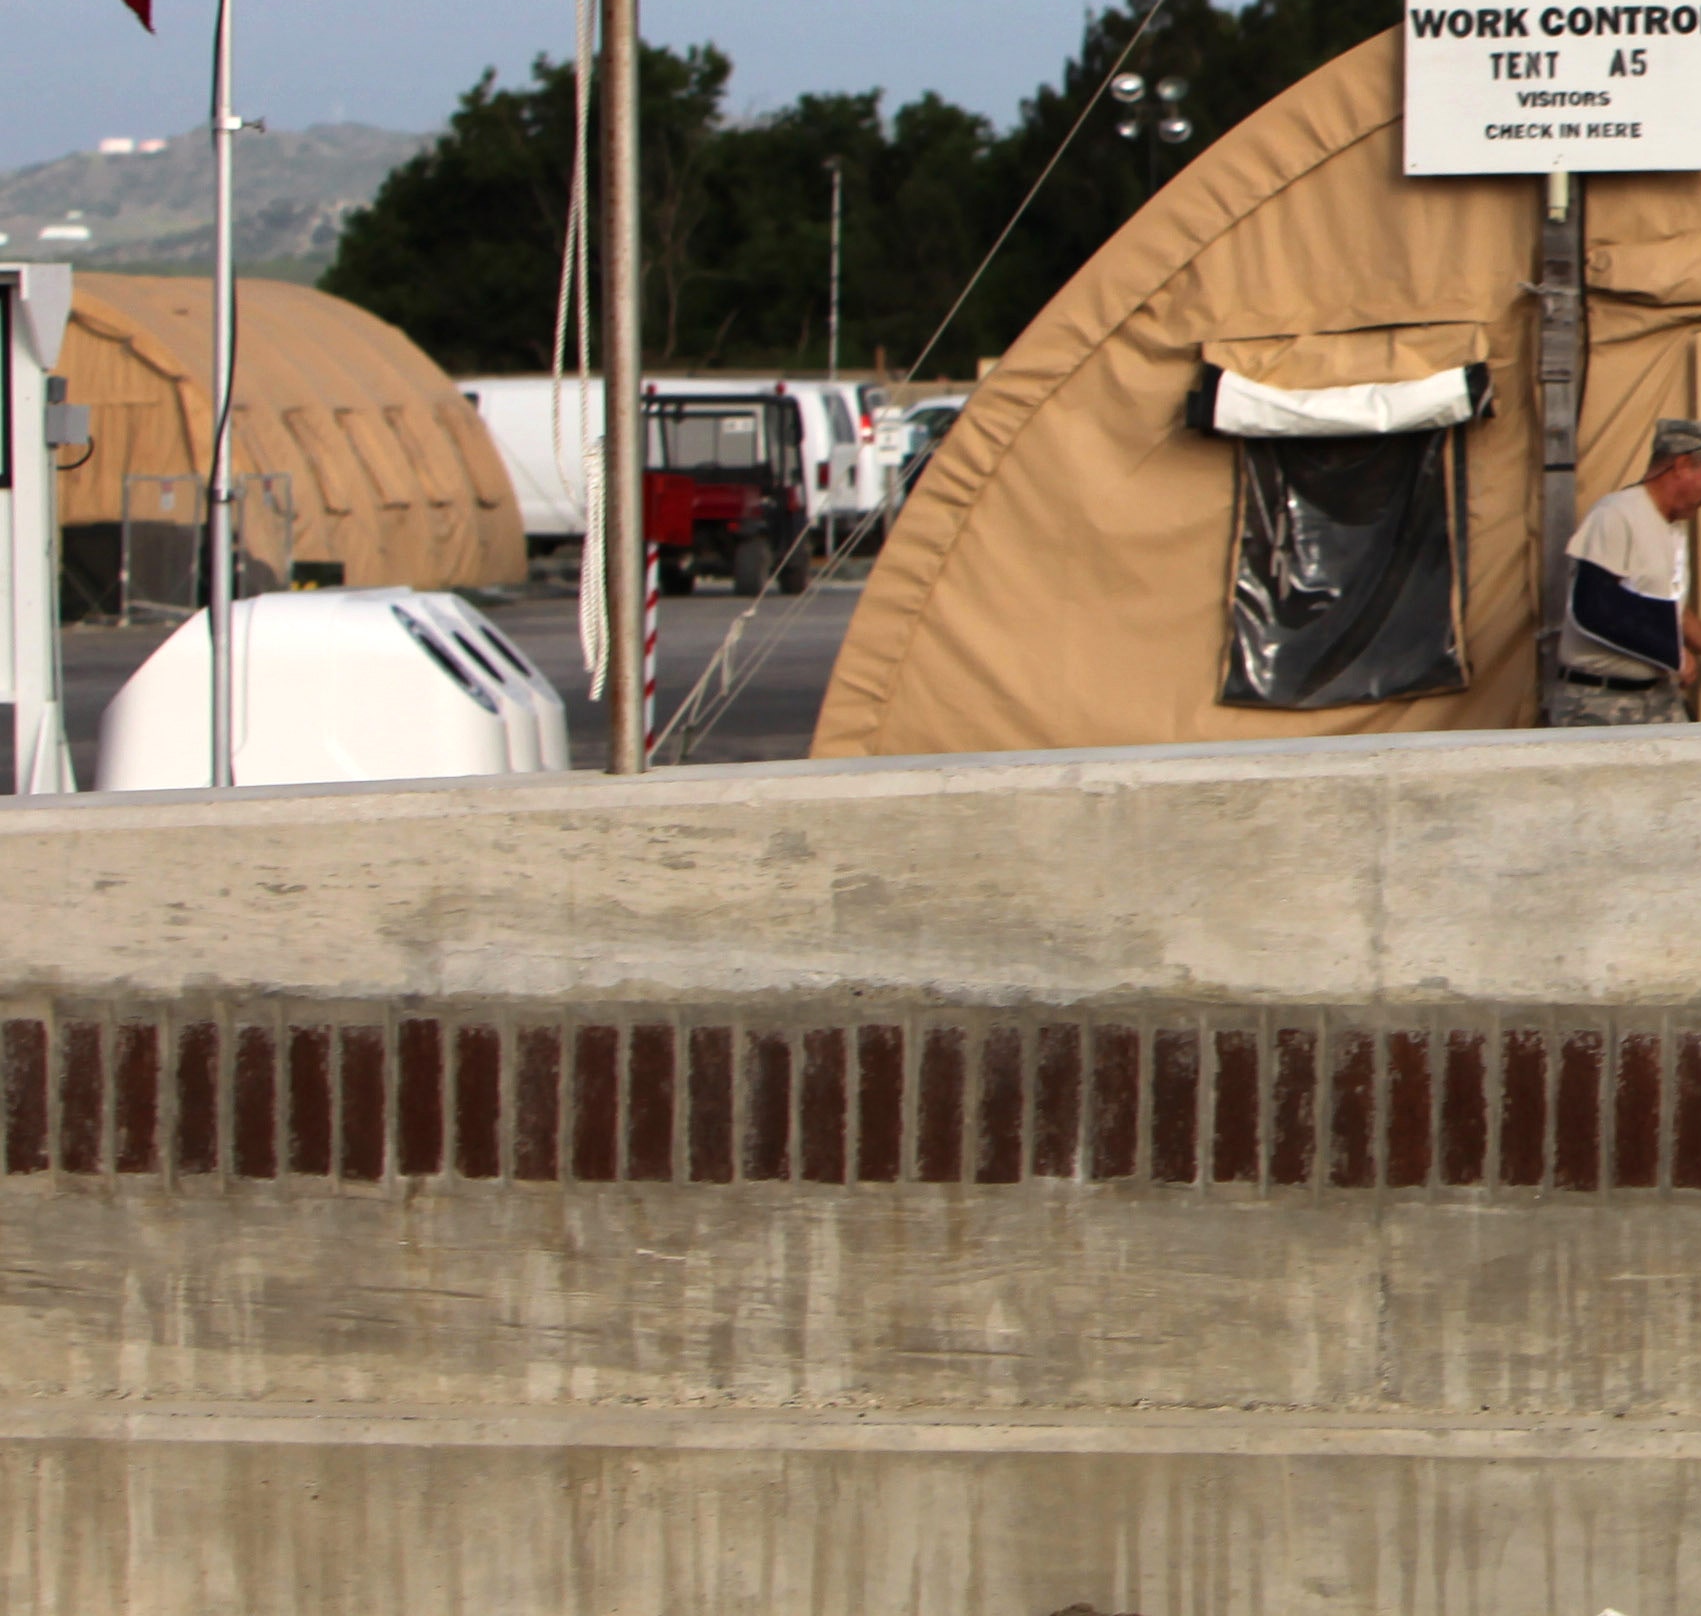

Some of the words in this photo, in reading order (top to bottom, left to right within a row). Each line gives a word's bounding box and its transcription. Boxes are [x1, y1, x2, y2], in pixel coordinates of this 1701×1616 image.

[1411, 9, 1528, 37] WORK
[1490, 52, 1558, 79] TENT
[1610, 49, 1646, 76] A5
[1518, 91, 1610, 107] VISITORS
[1485, 124, 1552, 139] CHECK
[1560, 124, 1580, 137] IN
[1587, 123, 1640, 138] HERE
